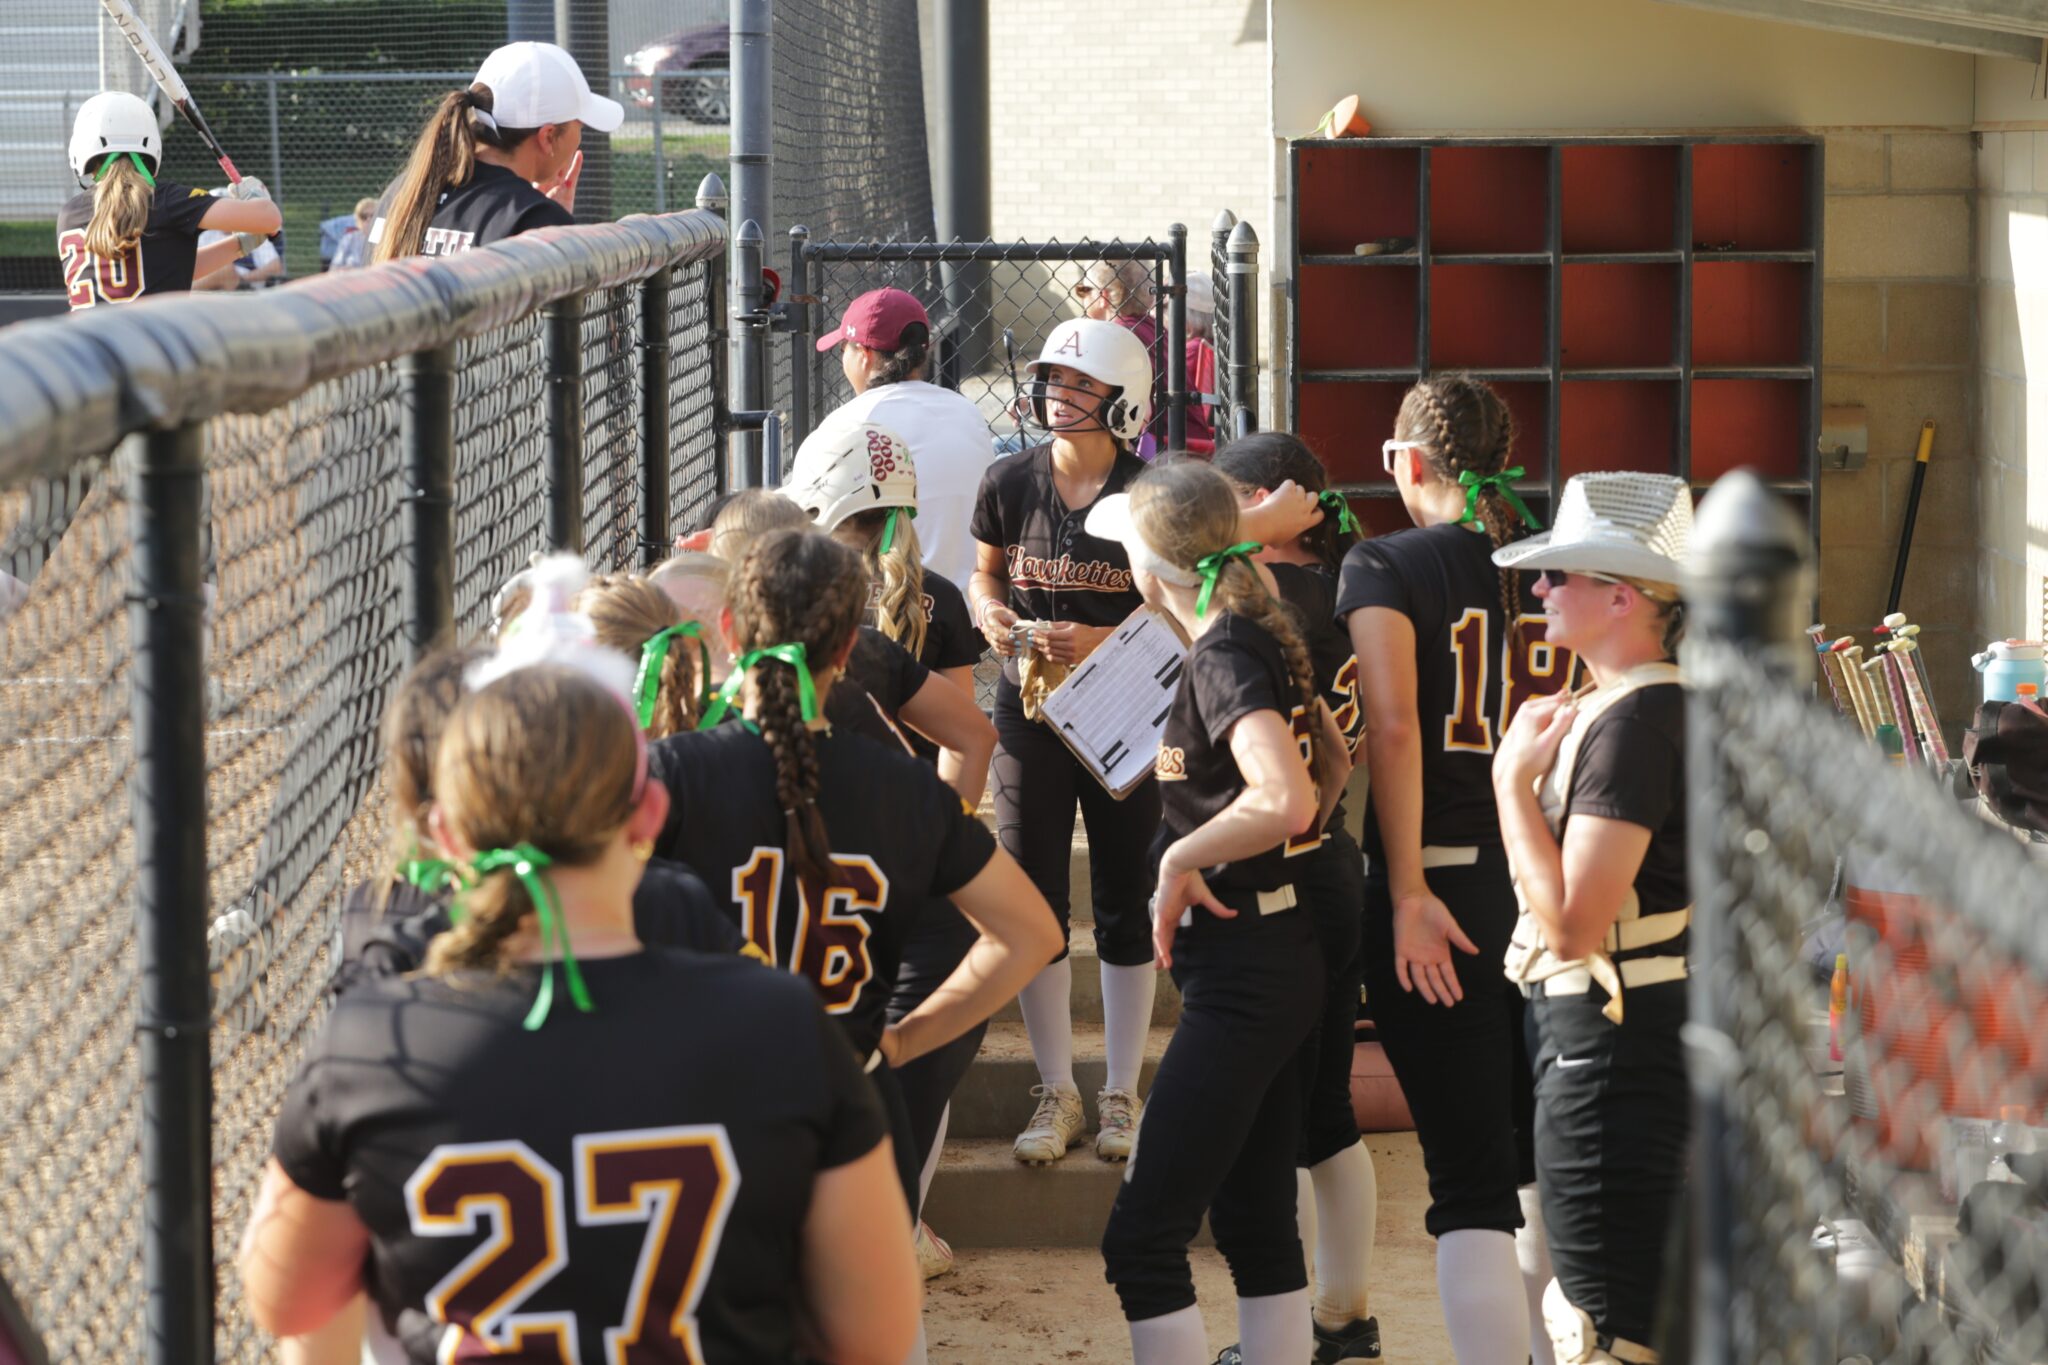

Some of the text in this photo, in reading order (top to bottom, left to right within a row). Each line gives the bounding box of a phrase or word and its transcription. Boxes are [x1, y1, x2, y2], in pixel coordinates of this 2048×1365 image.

[57, 228, 146, 312] 20
[1053, 329, 1083, 358] A
[1006, 543, 1134, 590] Hawkettes
[1443, 606, 1579, 755] 18
[731, 845, 890, 1015] 16
[403, 1122, 743, 1365] 27
